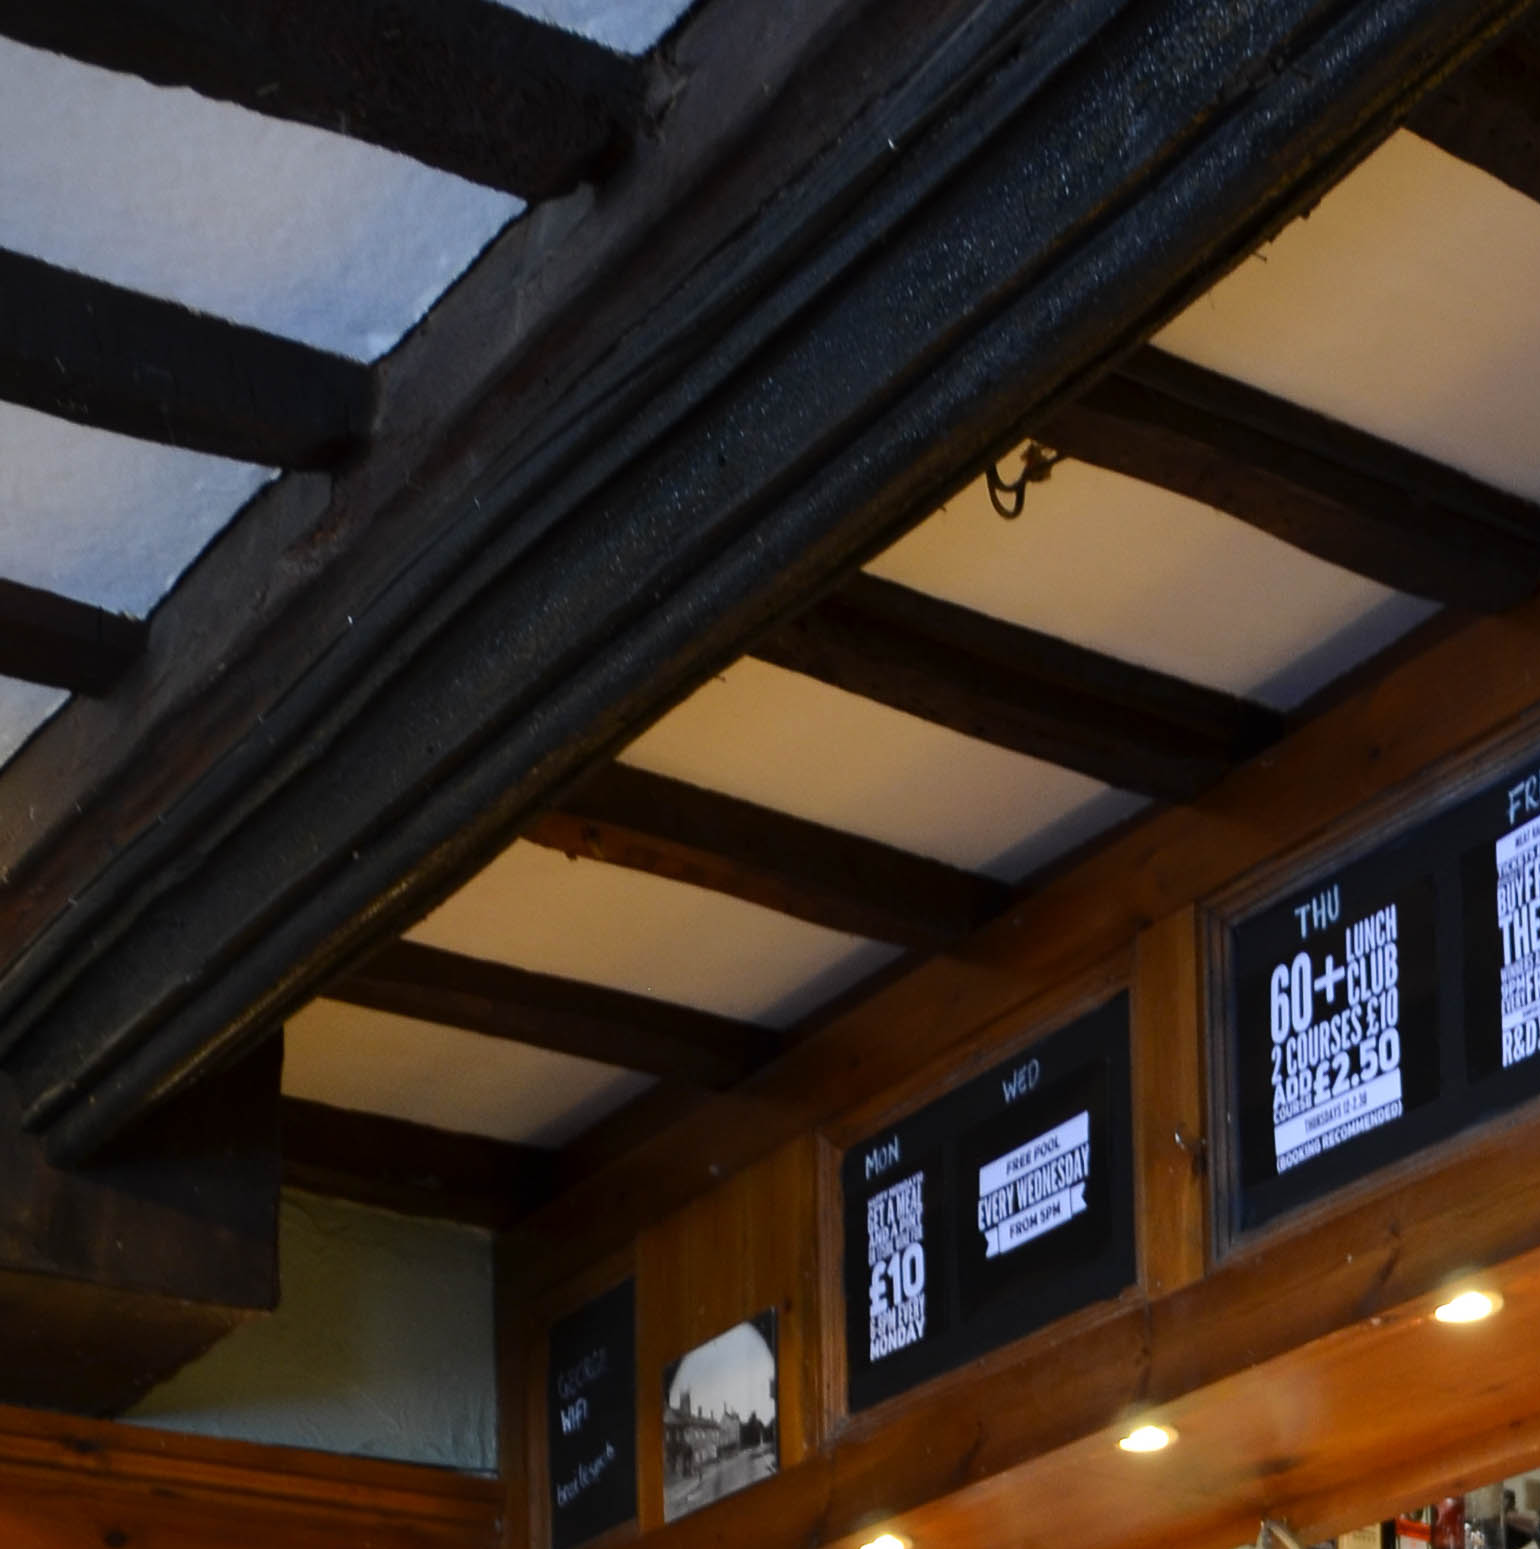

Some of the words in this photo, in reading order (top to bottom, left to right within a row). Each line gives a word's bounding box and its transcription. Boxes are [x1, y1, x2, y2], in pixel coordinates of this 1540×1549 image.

[1294, 883, 1340, 939] THU
[1498, 872, 1524, 916] BUY
[1345, 902, 1398, 962] LUNCH
[1270, 951, 1345, 1046] 60+
[1347, 942, 1399, 1007] CLUB
[1271, 1044, 1283, 1086] 2
[1286, 1003, 1363, 1076] COURSES
[1366, 985, 1399, 1038] £10
[1502, 1020, 1538, 1068] R&D
[1002, 1058, 1041, 1103] WED
[1273, 1067, 1313, 1112] ADD
[1313, 1026, 1401, 1105] £2.50
[865, 1135, 900, 1181] MON
[1006, 1152, 1032, 1176] FREE
[1277, 1135, 1322, 1176] (BOOKING
[1321, 1099, 1403, 1151] RECOMMENDED)
[978, 1182, 1014, 1232] EVERY
[1015, 1143, 1089, 1213] WEDNESDAY
[1009, 1214, 1038, 1239] FROM
[869, 1241, 925, 1316] £10
[869, 1318, 925, 1362] MONDAY
